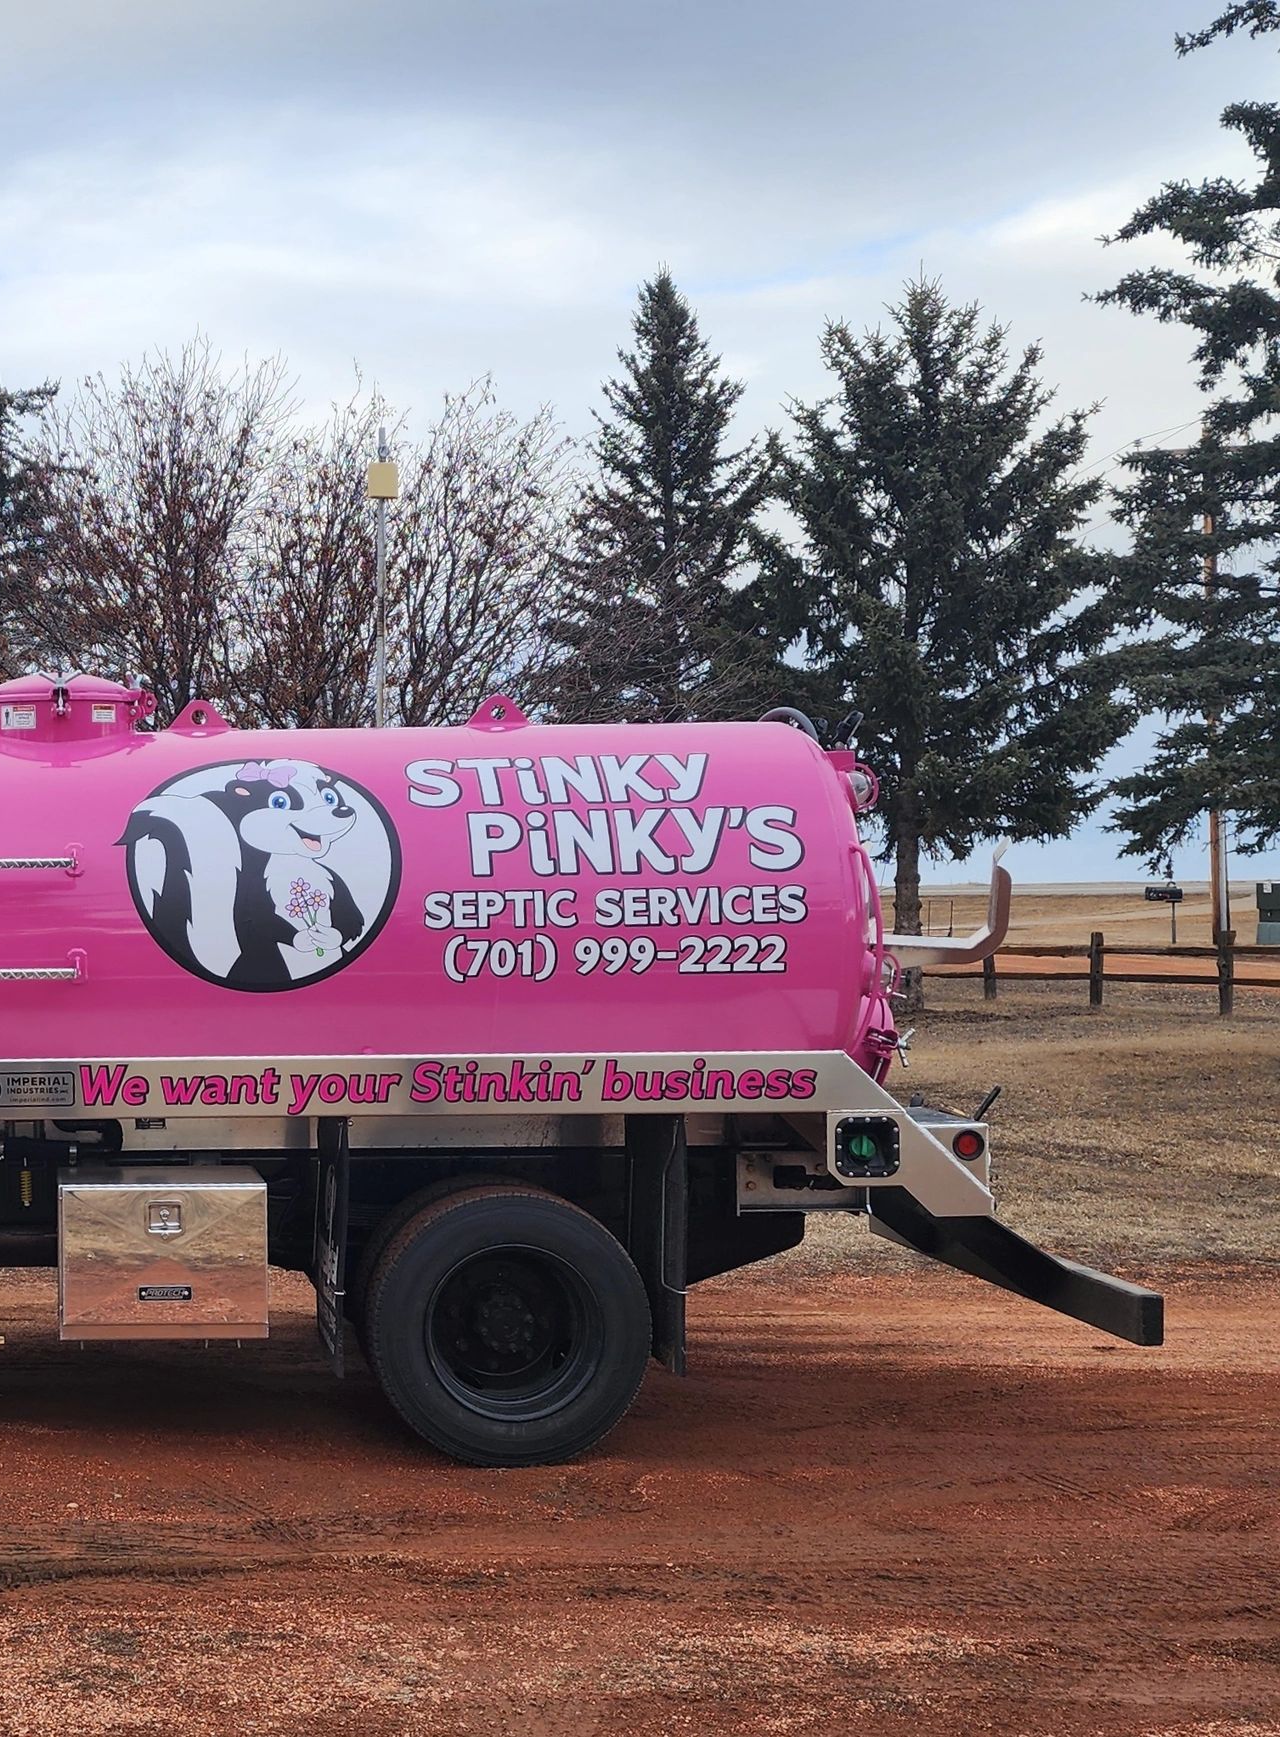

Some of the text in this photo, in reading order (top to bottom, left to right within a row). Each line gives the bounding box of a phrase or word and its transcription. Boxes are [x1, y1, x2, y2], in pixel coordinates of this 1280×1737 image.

[423, 884, 808, 930] SEPTIC SERVICES
[443, 934, 787, 982] (701) 999-2222
[6, 1077, 69, 1086] IMPERIAL
[79, 1058, 818, 1115] We want your Stinkin' business
